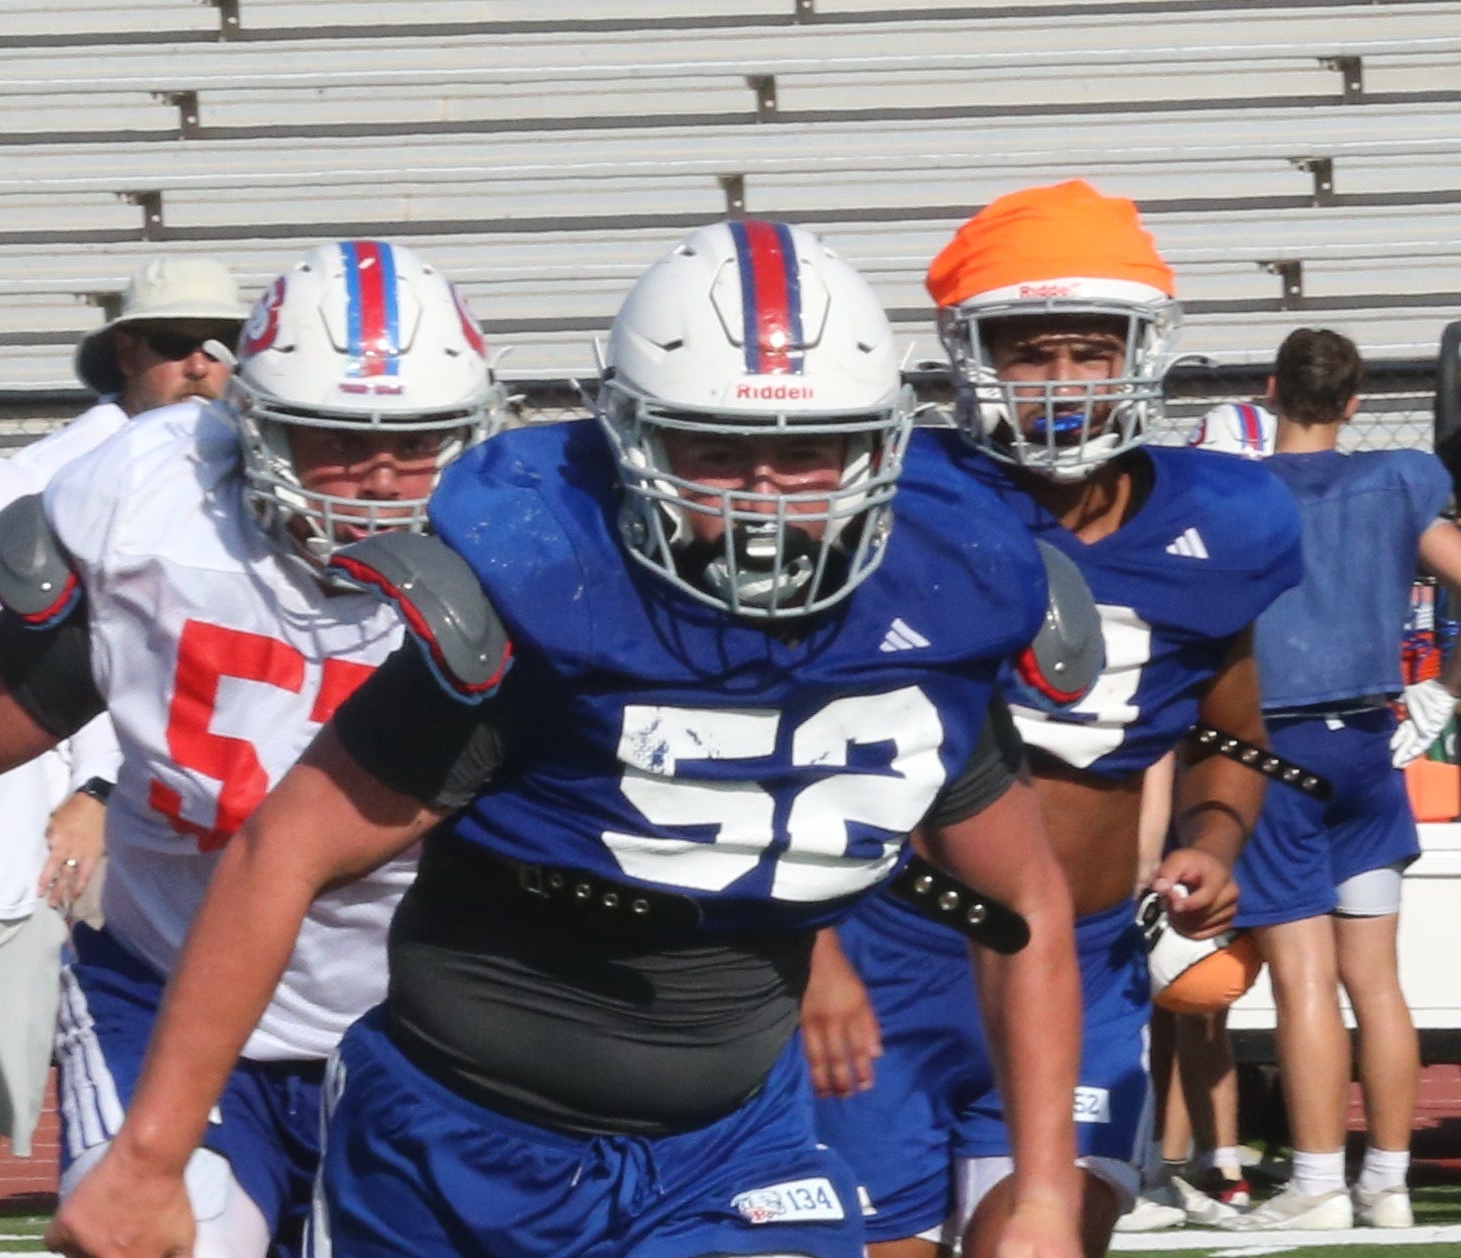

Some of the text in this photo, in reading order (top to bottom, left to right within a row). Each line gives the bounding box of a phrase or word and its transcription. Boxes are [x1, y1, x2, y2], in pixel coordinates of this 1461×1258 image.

[736, 384, 815, 400] Riddell
[601, 684, 947, 902] 52
[786, 1186, 833, 1212] 134
